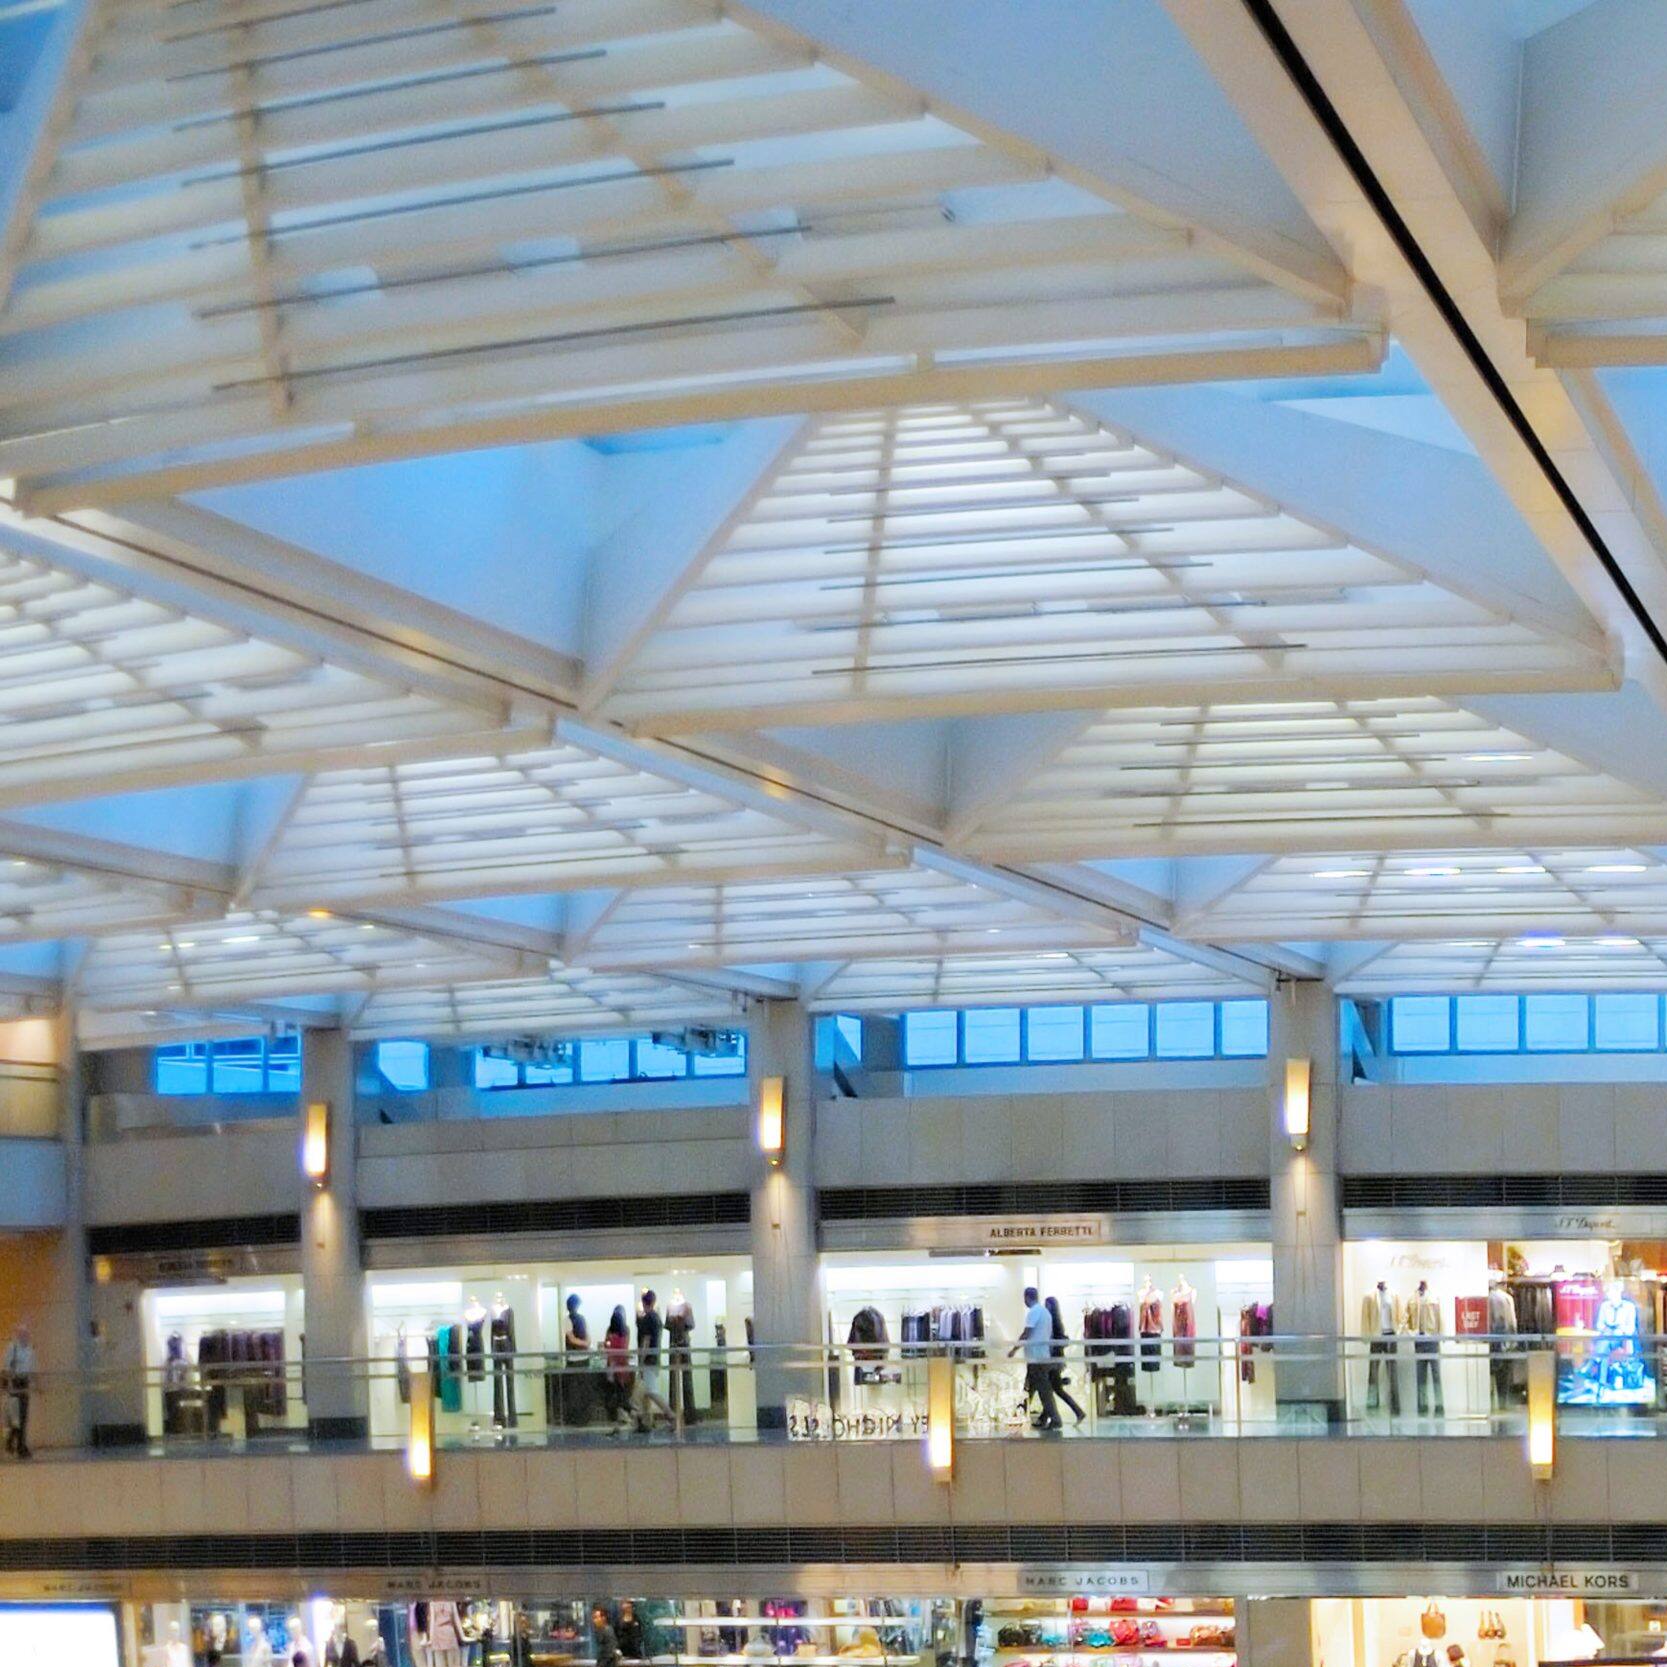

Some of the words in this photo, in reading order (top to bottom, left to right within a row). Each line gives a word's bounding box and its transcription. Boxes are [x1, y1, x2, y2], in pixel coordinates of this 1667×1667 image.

[1024, 1576, 1067, 1586] MARC
[1074, 1575, 1140, 1586] JACOBS
[1506, 1574, 1579, 1588] MICHAEL
[1584, 1574, 1630, 1588] KORS
